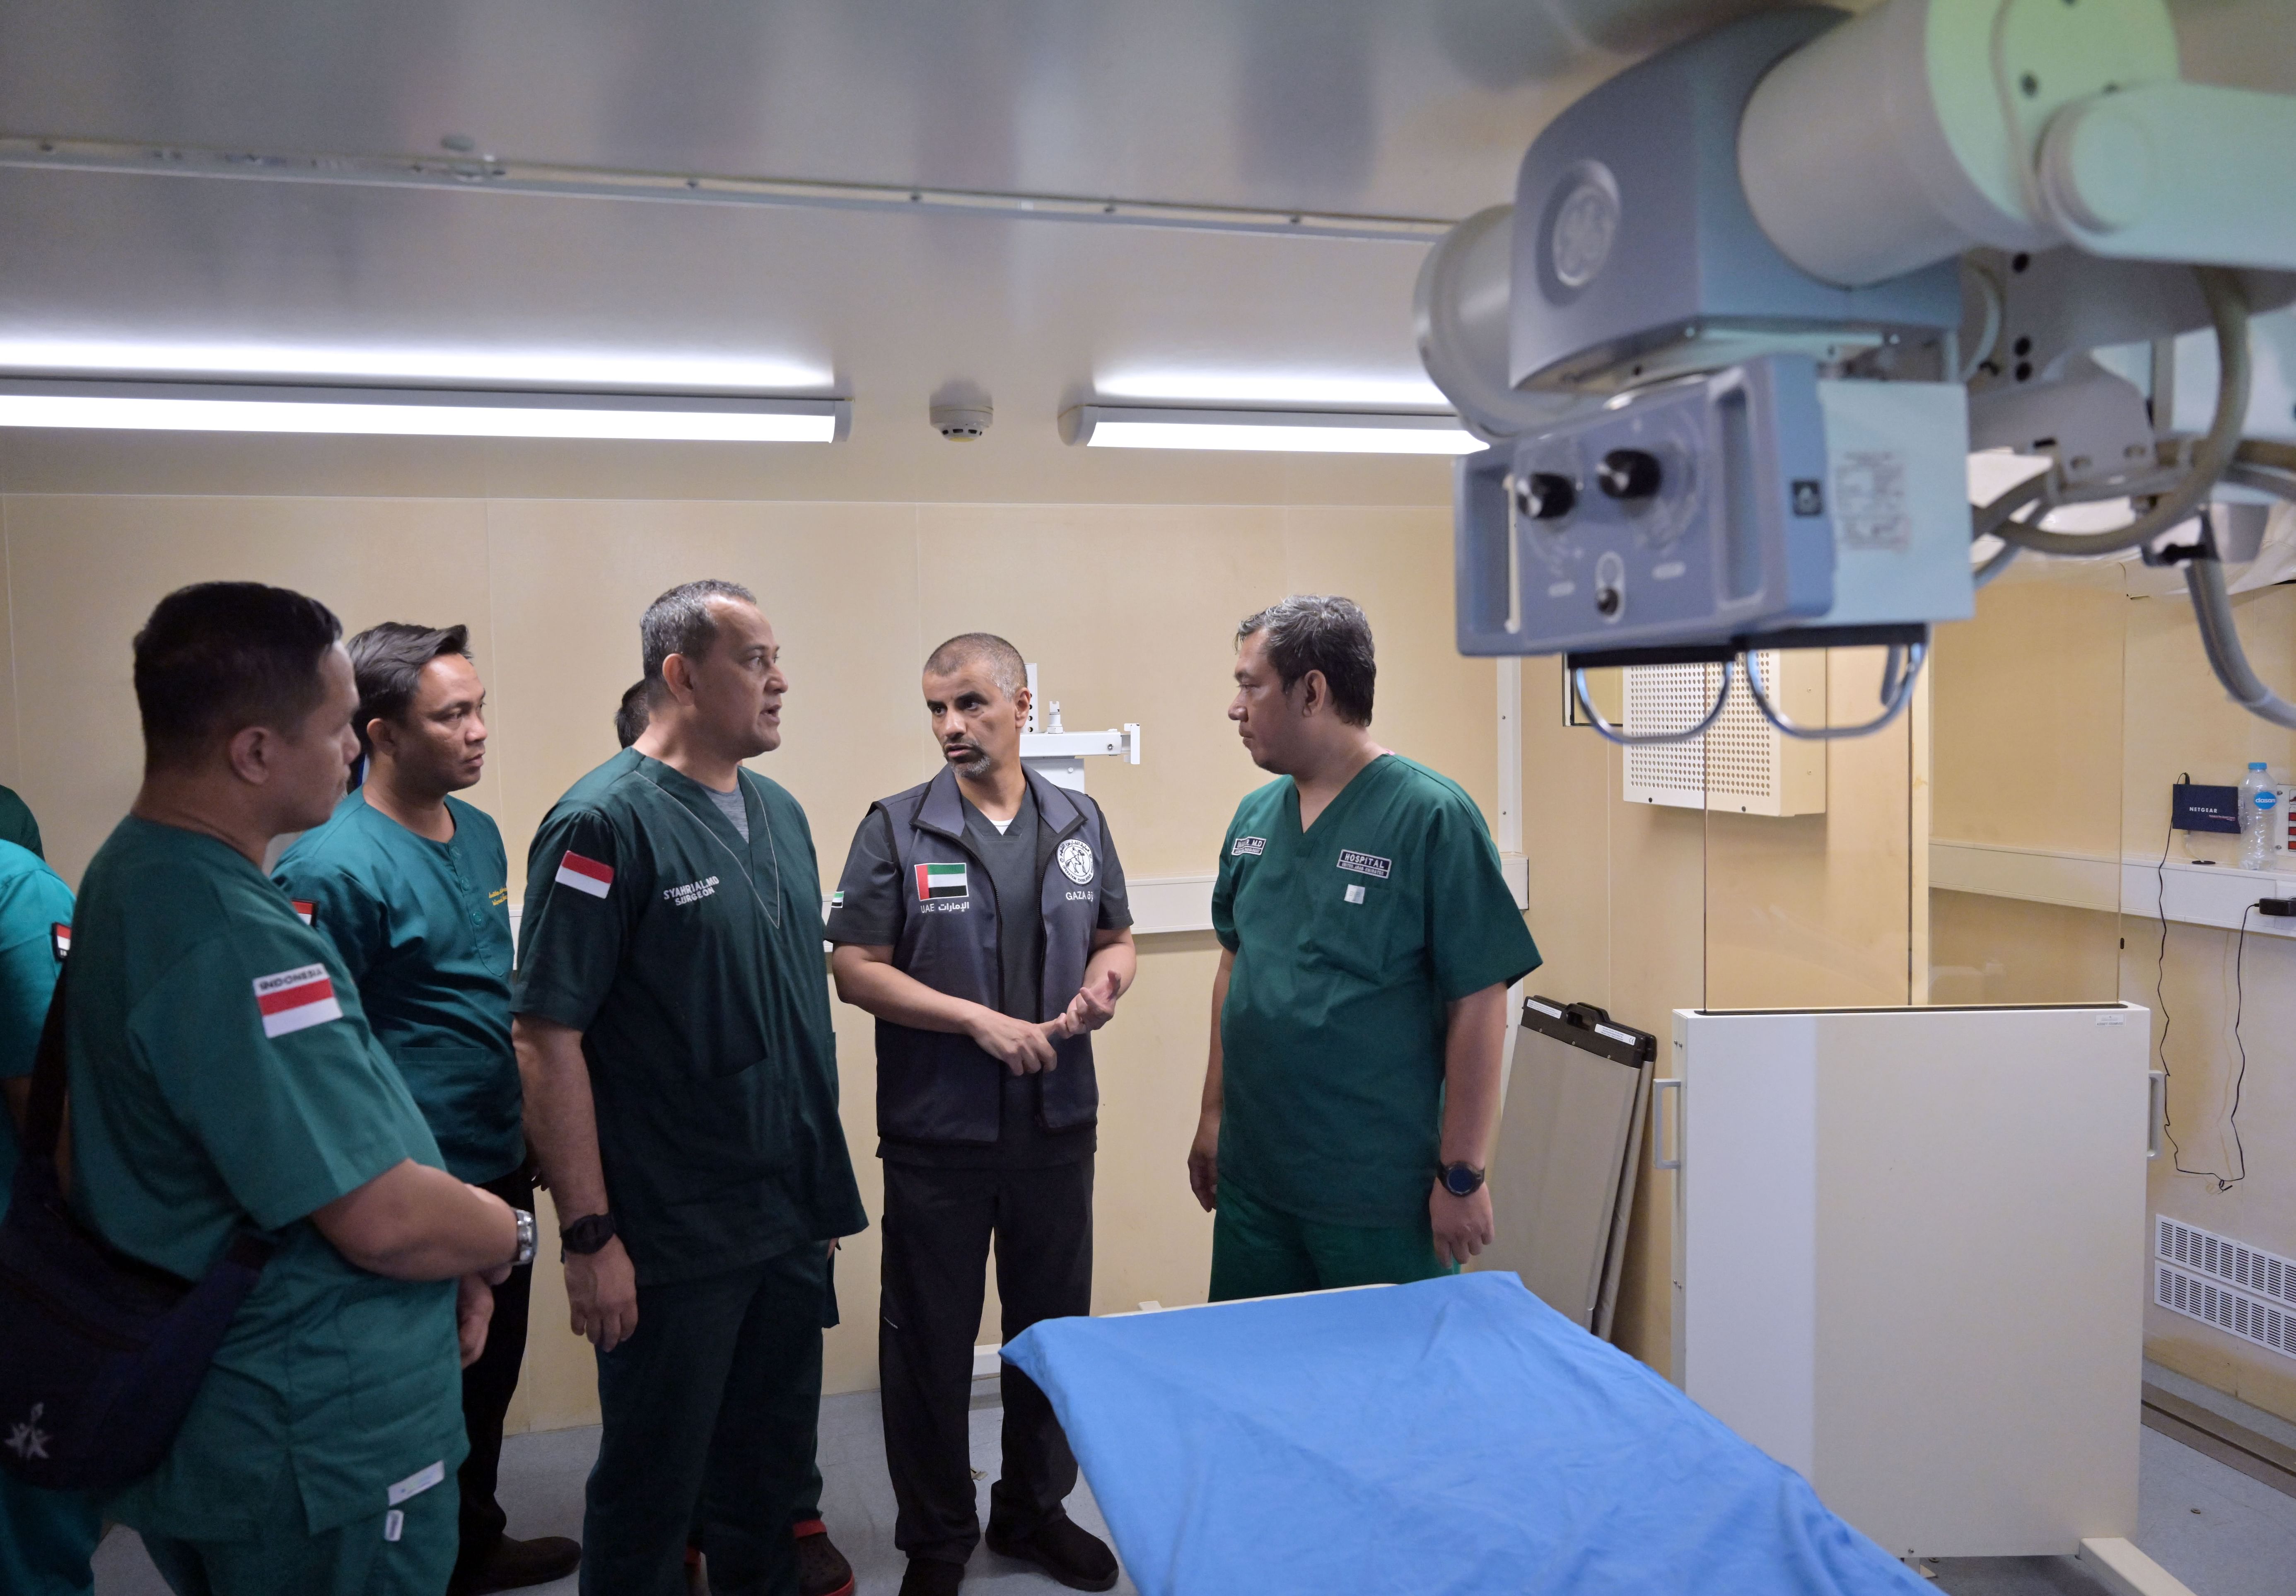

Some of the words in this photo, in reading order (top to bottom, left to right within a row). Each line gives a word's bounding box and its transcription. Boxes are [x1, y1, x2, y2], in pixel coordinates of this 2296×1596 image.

[1345, 853, 1385, 869] HOSPITAL
[1062, 865, 1077, 880] OPERATION
[675, 886, 715, 906] SURGEON
[1065, 891, 1086, 900] GAZA
[920, 903, 934, 913] UAE
[938, 902, 969, 912] الإمارات
[259, 968, 322, 990] INDONESIA
